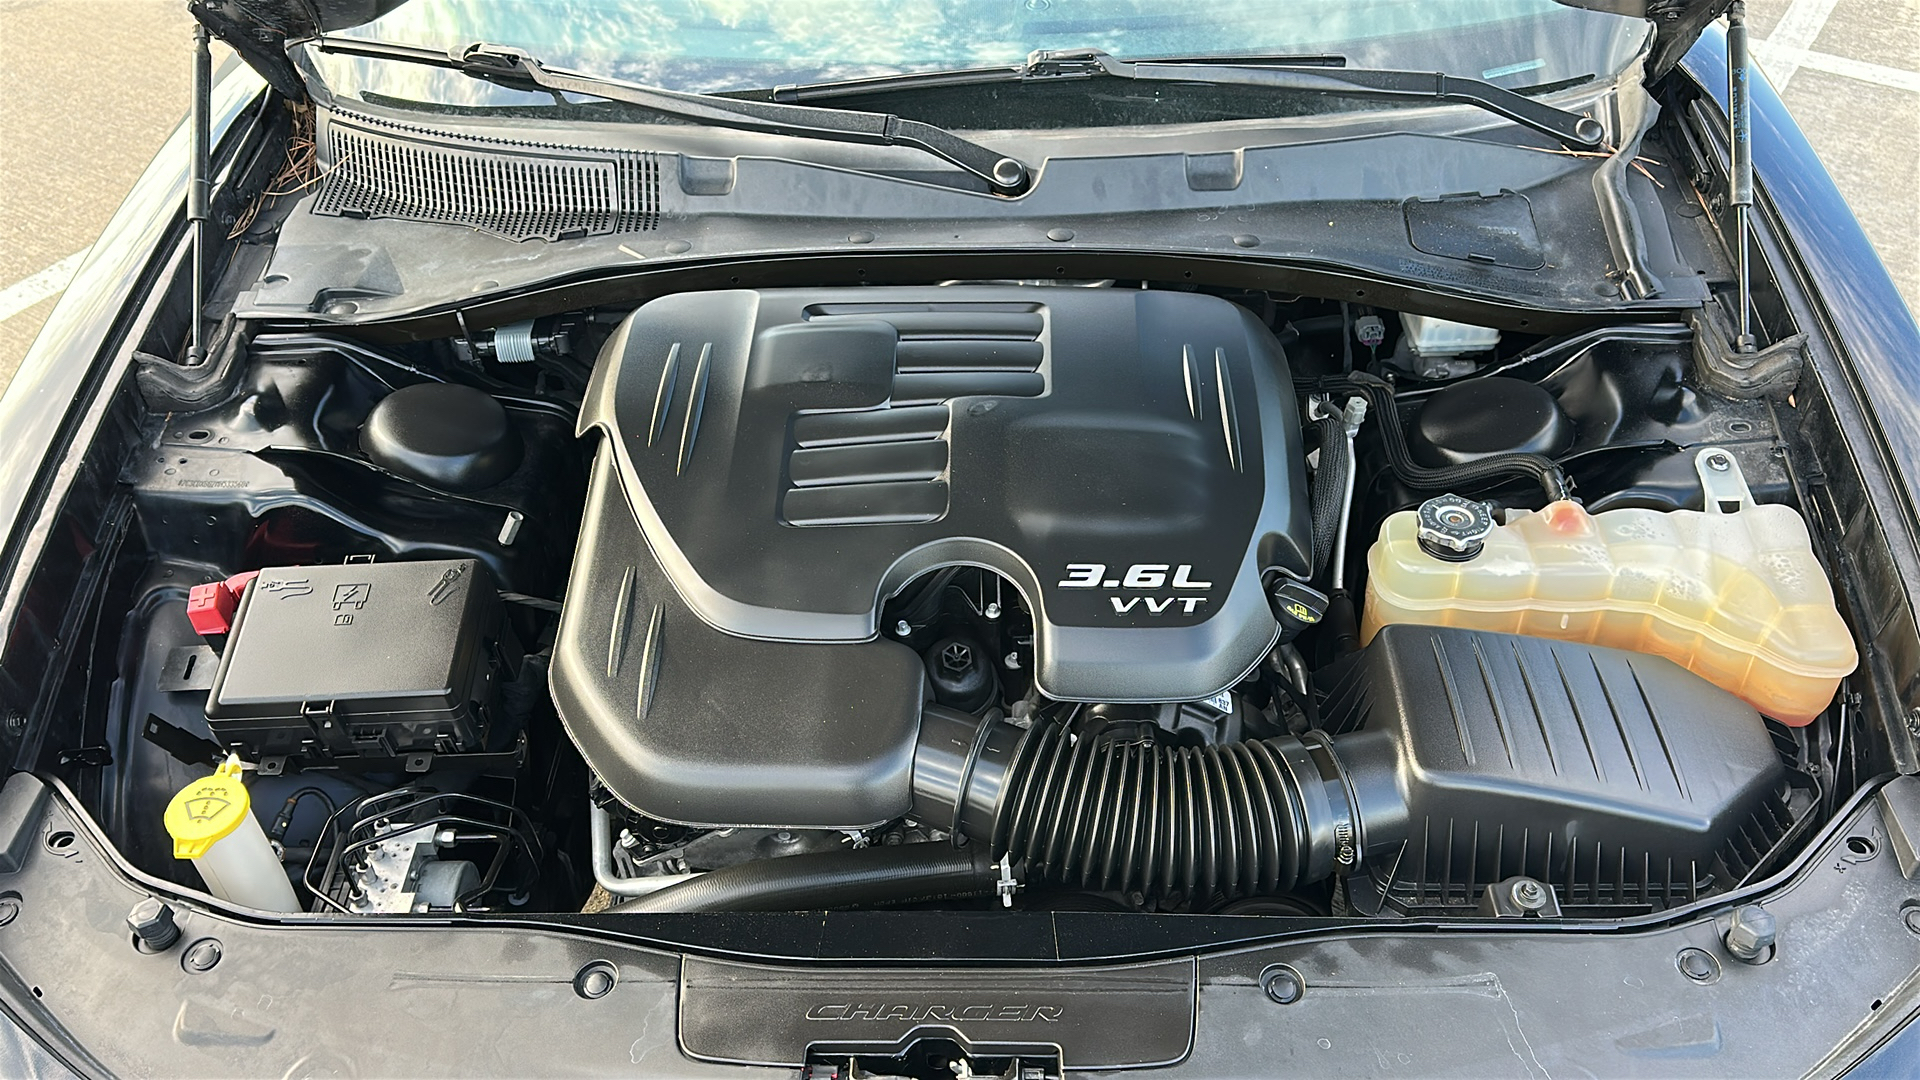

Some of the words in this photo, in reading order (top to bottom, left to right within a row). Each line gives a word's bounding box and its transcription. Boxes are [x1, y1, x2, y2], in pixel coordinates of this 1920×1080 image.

[1058, 563, 1213, 590] 3.6L
[1109, 597, 1208, 616] VVT
[805, 1003, 1064, 1022] CHARGER
